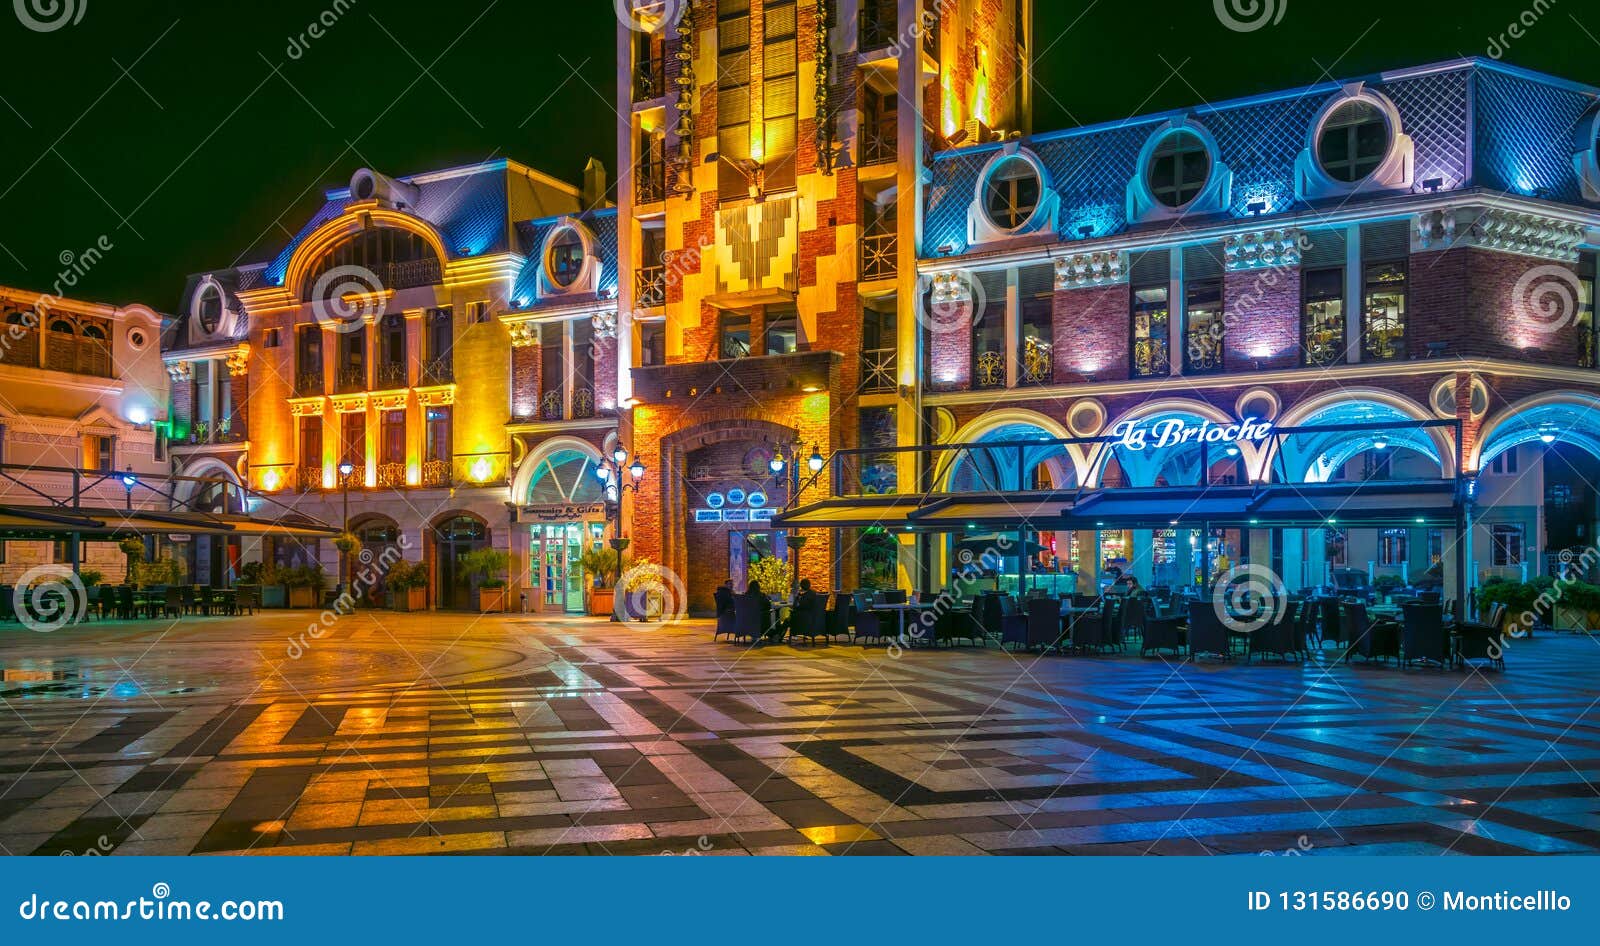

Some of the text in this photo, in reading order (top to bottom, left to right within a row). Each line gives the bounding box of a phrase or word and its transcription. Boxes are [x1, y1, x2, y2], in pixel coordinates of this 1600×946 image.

[1110, 417, 1273, 450] La Brioche
[565, 505, 575, 513] &
[576, 505, 600, 514] Gifts
